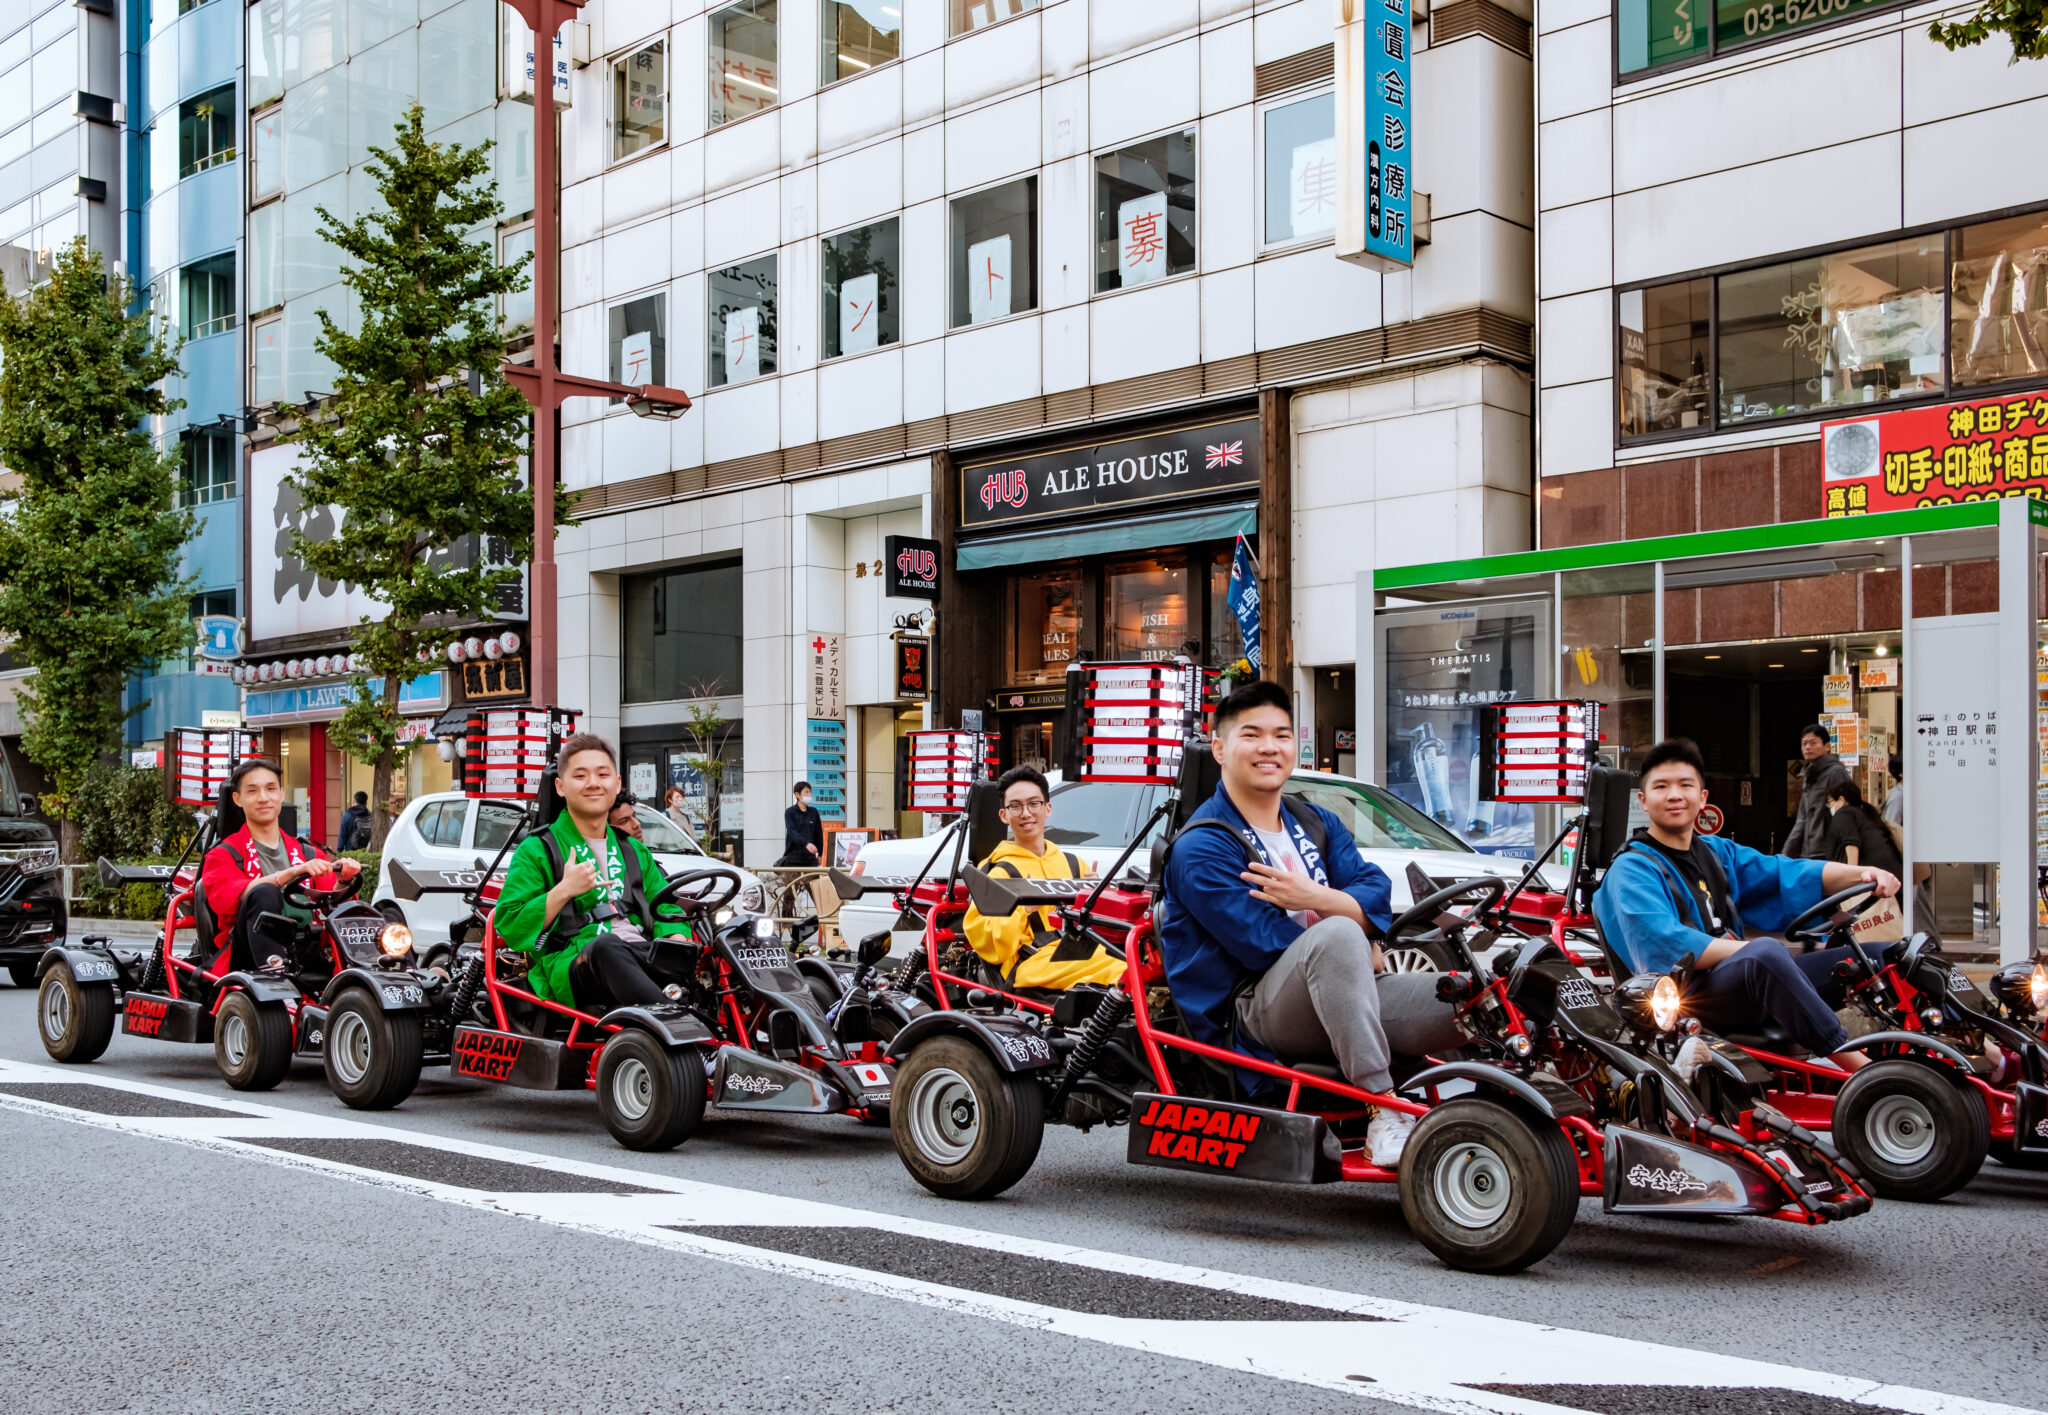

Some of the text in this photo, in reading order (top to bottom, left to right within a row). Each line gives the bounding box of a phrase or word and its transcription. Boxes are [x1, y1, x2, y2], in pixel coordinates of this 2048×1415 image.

[627, 349, 648, 385] テ
[731, 325, 755, 366] ナ
[849, 298, 873, 333] ン
[986, 256, 1003, 300] ト
[1124, 211, 1164, 268] 募
[980, 449, 1189, 511] HUB ALE HOUSE
[897, 548, 937, 581] HUB
[898, 578, 936, 589] ALE HOUSE
[1141, 613, 1169, 627] FISH
[1147, 633, 1157, 644] &
[1431, 653, 1491, 666] THERATIS
[829, 636, 839, 718] メディカルモール
[902, 672, 922, 689] HUB
[1185, 665, 1194, 712] JAPANKART
[1195, 665, 1203, 713] JAPANKART
[1585, 702, 1593, 741] JAPANKART
[1957, 711, 1997, 722] のりば
[1928, 723, 1997, 737] 神田駅前
[1927, 739, 1965, 747] Kanda
[1293, 824, 1330, 888] JAPA
[738, 947, 787, 961] JAPAN
[749, 957, 789, 970] KART
[125, 998, 168, 1019] JAPAN
[128, 1015, 162, 1035] KART
[455, 1030, 522, 1060] JAPAN
[459, 1052, 513, 1080] KART
[726, 1073, 784, 1094] 安全第一
[1140, 1100, 1262, 1142] JAPAN
[1147, 1130, 1246, 1168] KART
[1627, 1163, 1708, 1195] 安全第一
